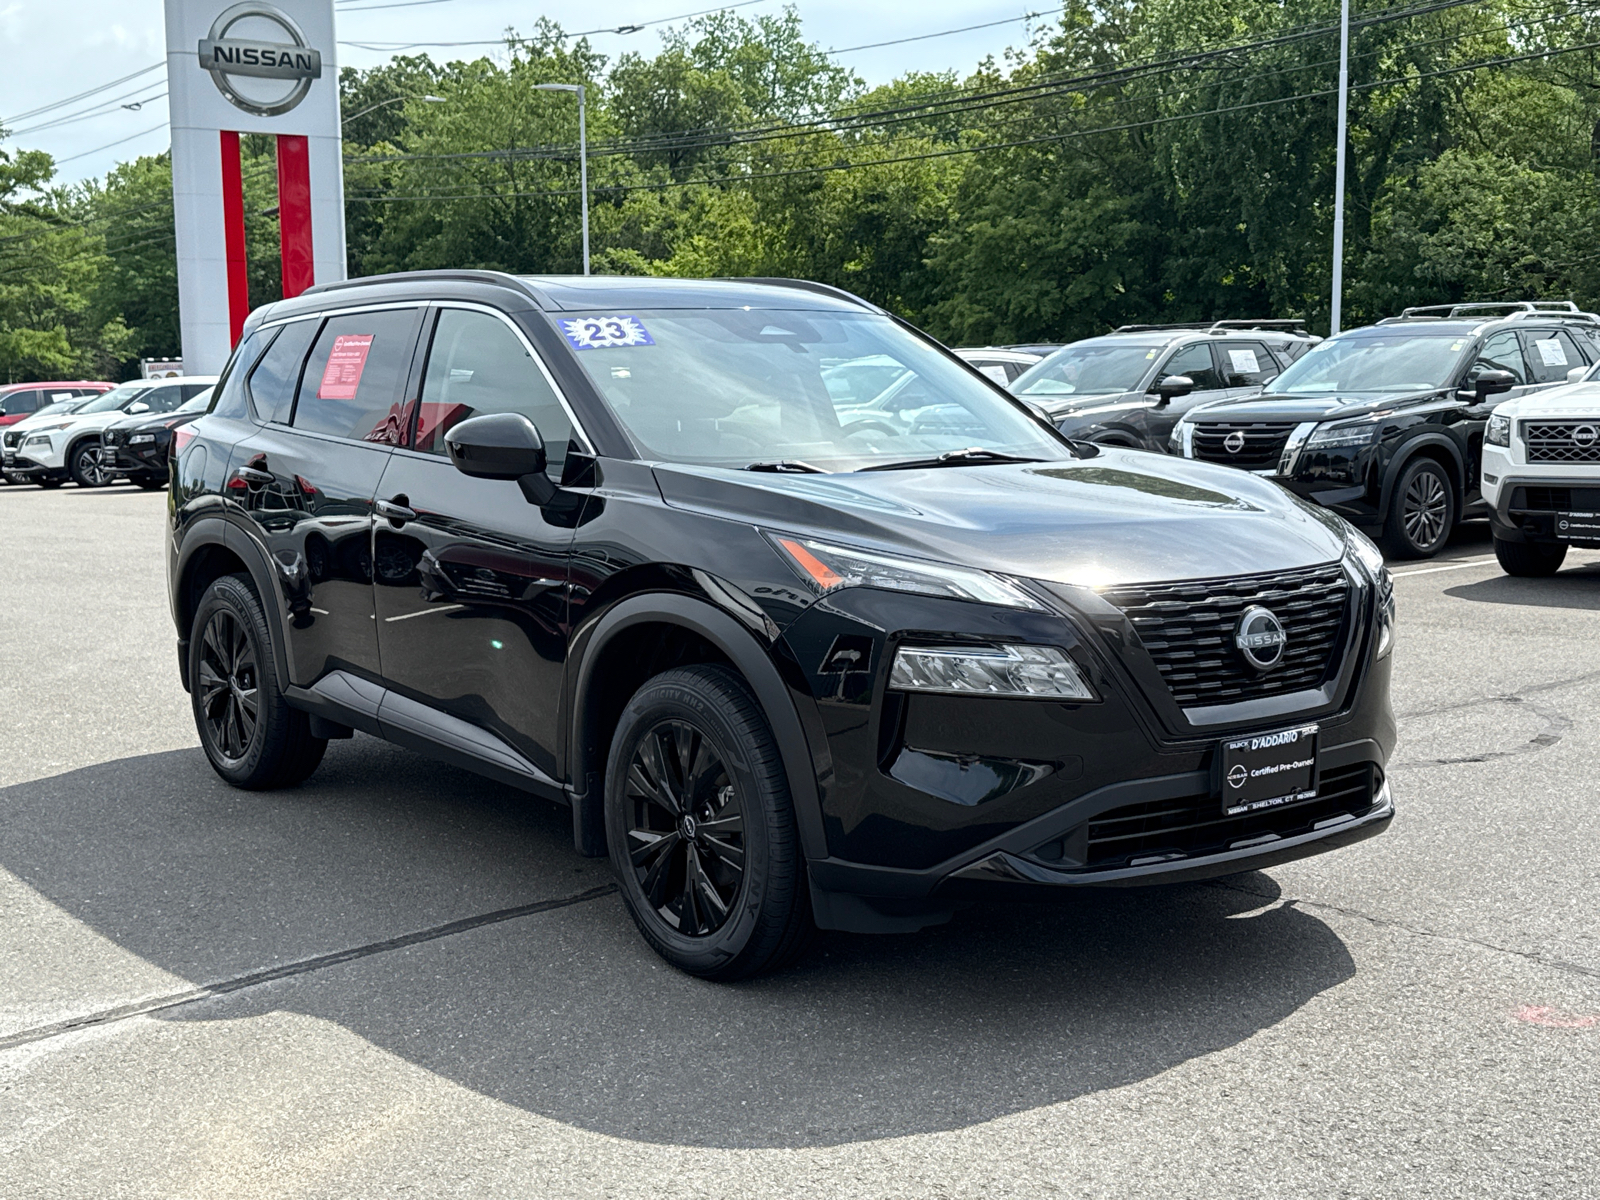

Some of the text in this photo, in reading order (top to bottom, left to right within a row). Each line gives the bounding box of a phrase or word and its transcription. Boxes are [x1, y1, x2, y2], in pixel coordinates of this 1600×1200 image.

[214, 46, 312, 70] NISSAN
[584, 322, 627, 341] 23
[1238, 630, 1286, 647] NISSAN
[683, 694, 704, 712] HH2
[1229, 741, 1249, 750] BUICK
[1251, 731, 1298, 750] D'ADDARIO
[1250, 757, 1315, 777] Certified Pre-Owned
